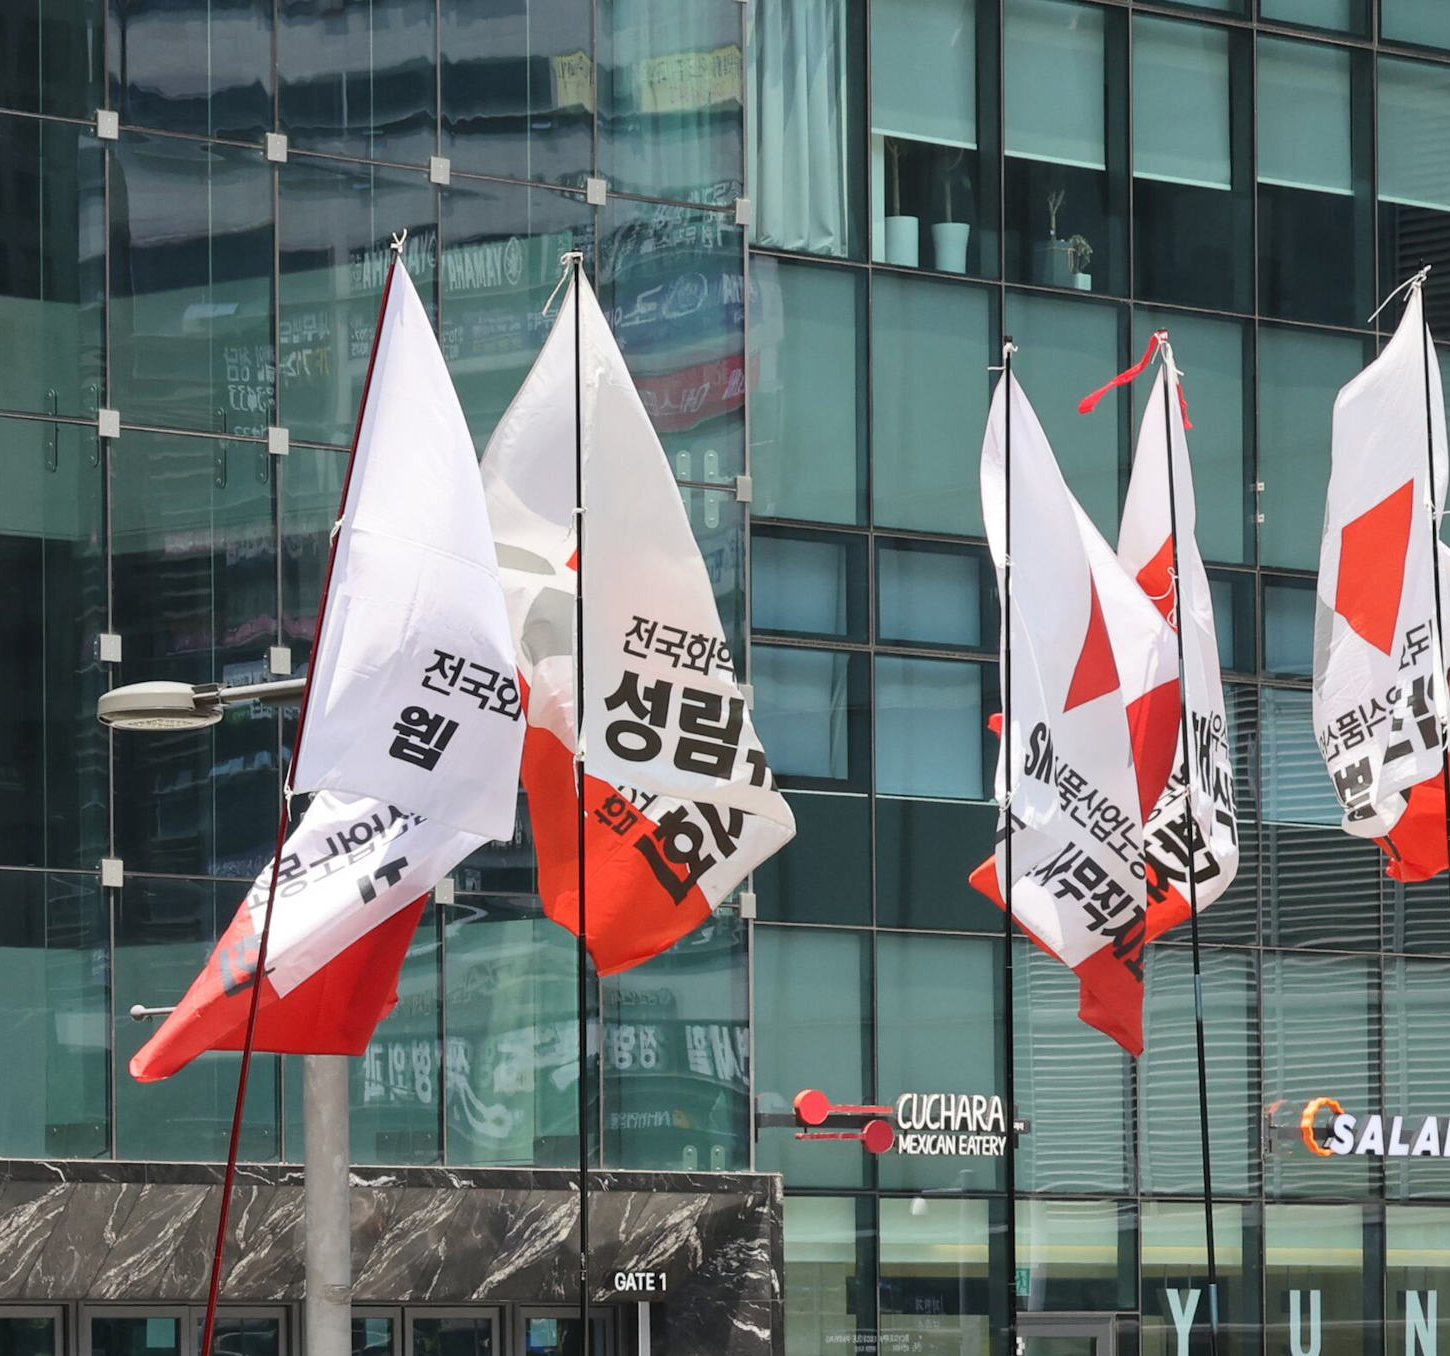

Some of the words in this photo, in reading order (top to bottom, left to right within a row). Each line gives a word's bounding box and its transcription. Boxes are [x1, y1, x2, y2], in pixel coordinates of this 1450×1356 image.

[897, 1093, 1005, 1132] CUCHARA
[898, 1134, 955, 1155] MEXICAN
[959, 1135, 1006, 1156] EATERY
[614, 1272, 655, 1291] GATE
[659, 1272, 667, 1291] 1
